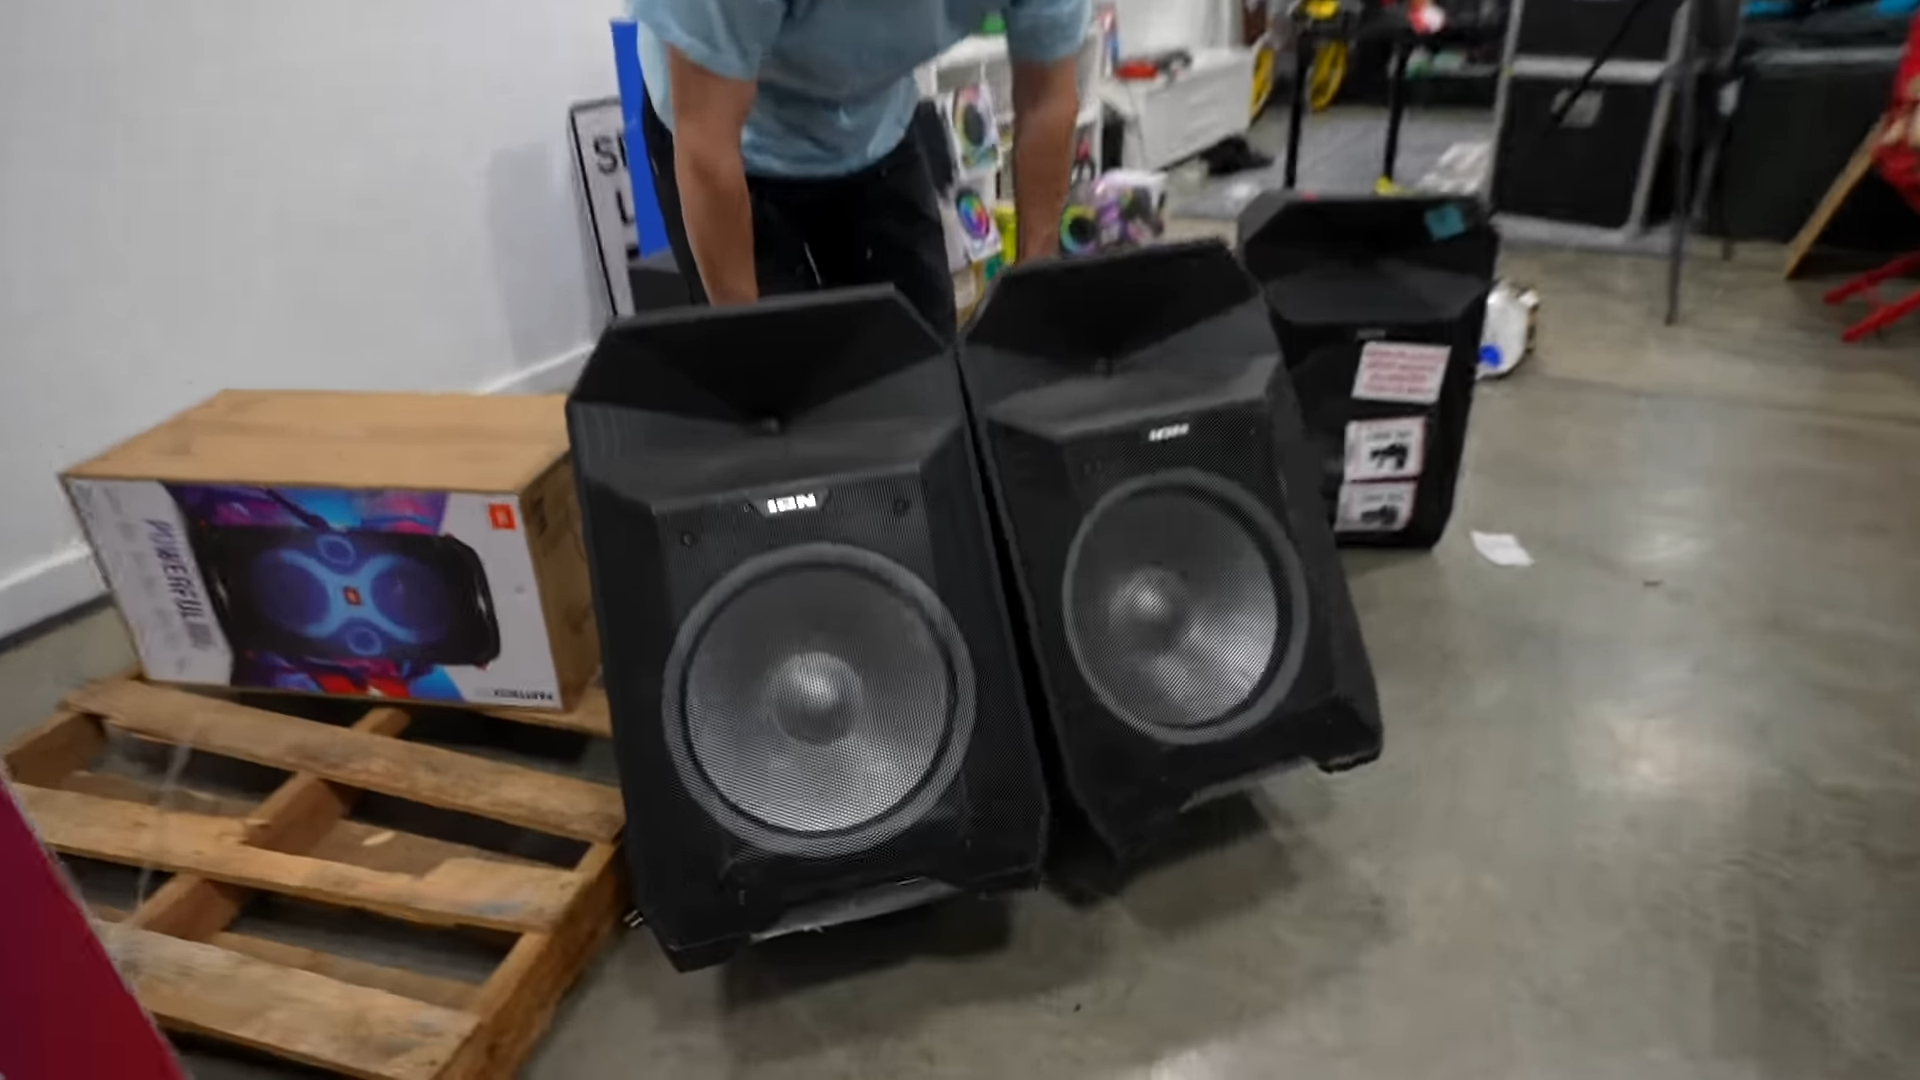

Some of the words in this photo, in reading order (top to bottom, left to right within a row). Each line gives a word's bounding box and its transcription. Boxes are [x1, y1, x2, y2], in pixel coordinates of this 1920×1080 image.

[594, 132, 627, 174] S
[768, 493, 816, 514] ION
[144, 518, 206, 620] POWERFUL
